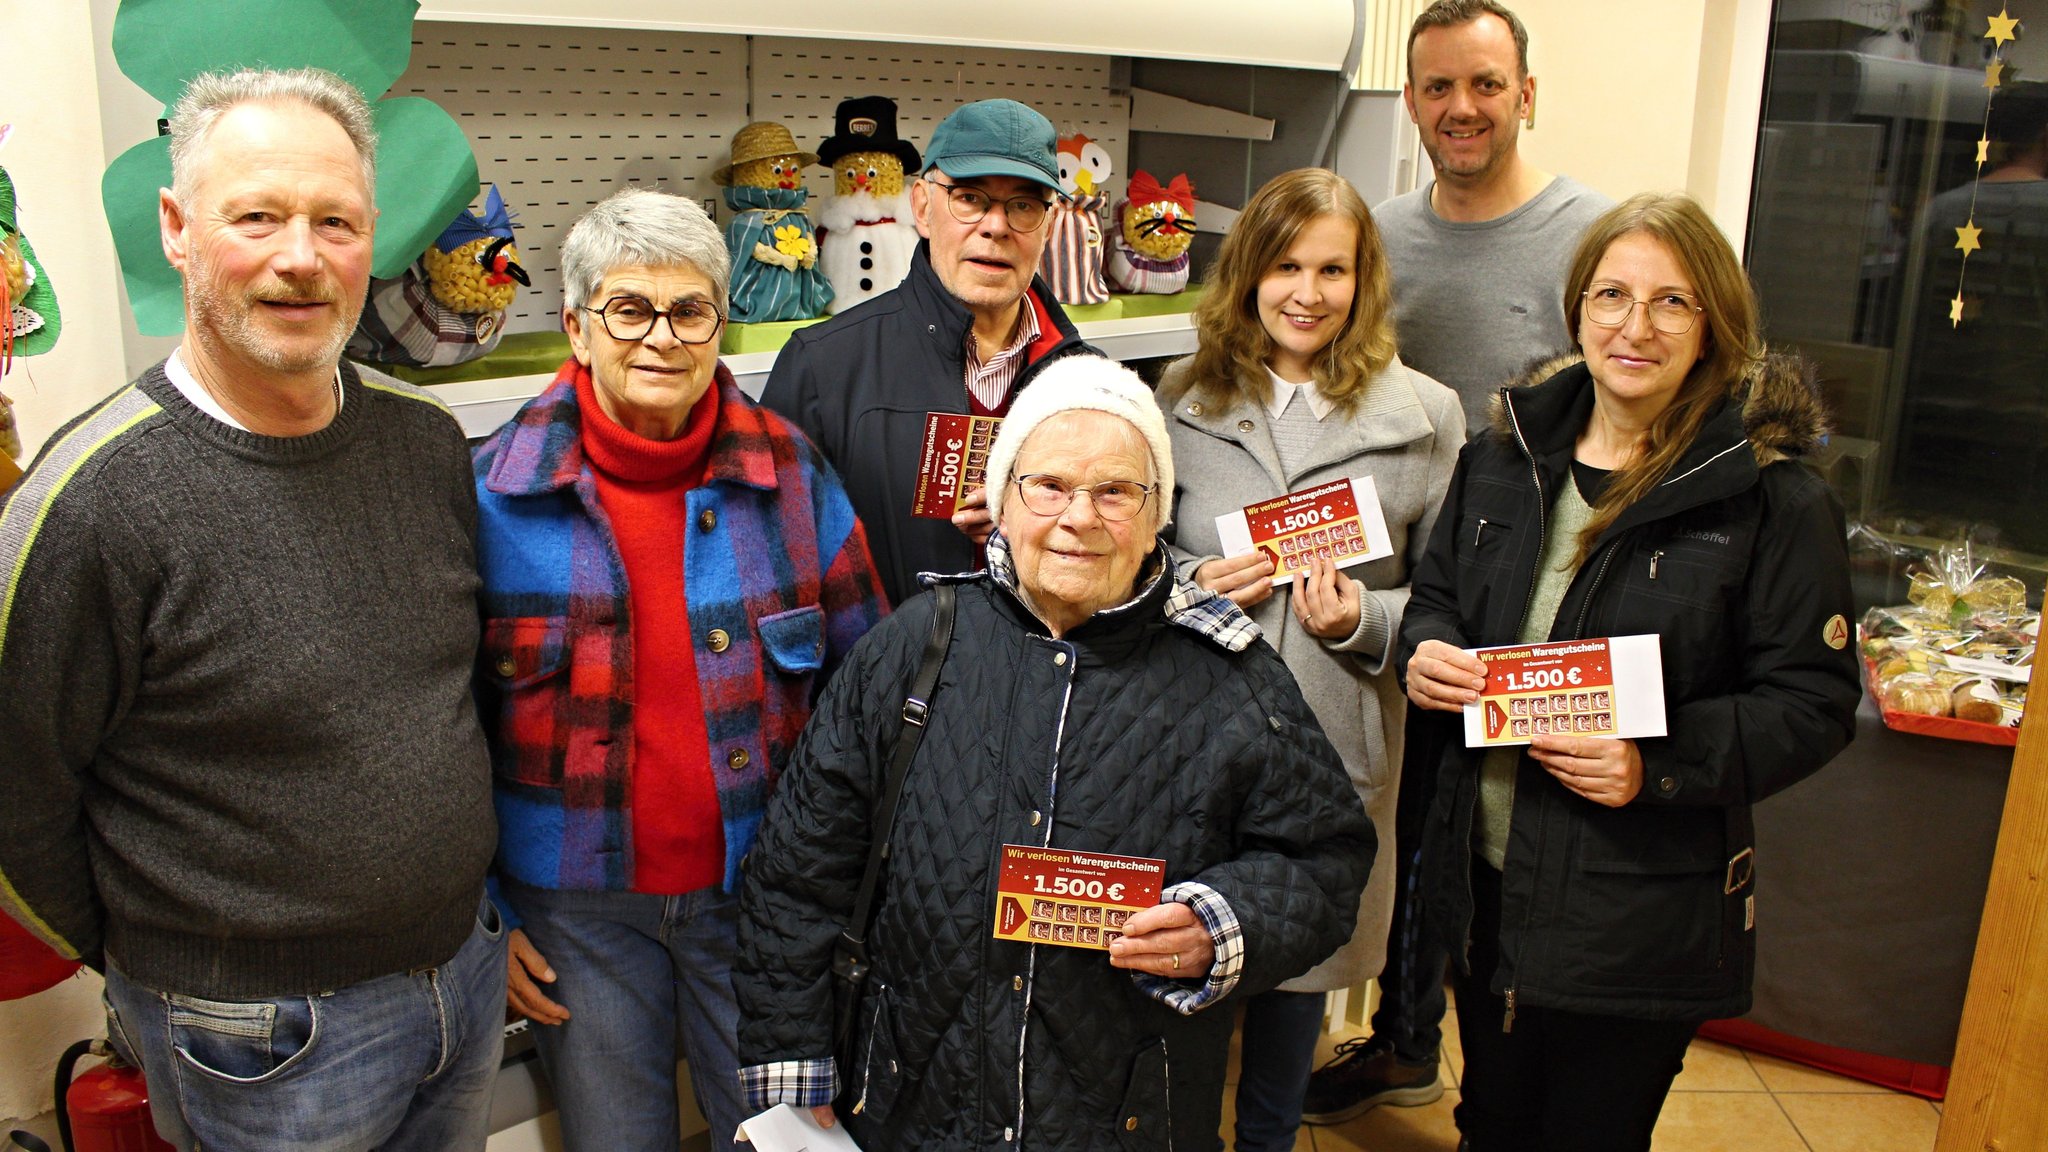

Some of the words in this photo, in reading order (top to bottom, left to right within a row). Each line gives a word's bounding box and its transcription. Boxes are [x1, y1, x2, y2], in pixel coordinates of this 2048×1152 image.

[921, 416, 939, 474] Warengutscheine
[946, 438, 963, 451] €
[938, 452, 960, 498] 1.500
[919, 475, 929, 502] verlosen
[1247, 507, 1259, 516] Wir
[1260, 499, 1290, 512] verlosen
[1289, 482, 1348, 504] Warengutscheine
[915, 503, 923, 514] Wir
[1271, 509, 1320, 535] 1.500
[1321, 505, 1334, 521] €
[1480, 652, 1494, 663] Wir
[1496, 650, 1531, 661] verlosen
[1532, 643, 1606, 657] Warengutscheine
[1506, 668, 1564, 691] 1.500
[1566, 667, 1583, 685] €
[1007, 849, 1025, 859] Wir
[1027, 851, 1070, 863] verlosen
[1072, 855, 1160, 873] Warengutscheine
[1066, 868, 1096, 876] Gesamtwert
[1033, 875, 1104, 899] 1.500
[1106, 883, 1126, 901] €
